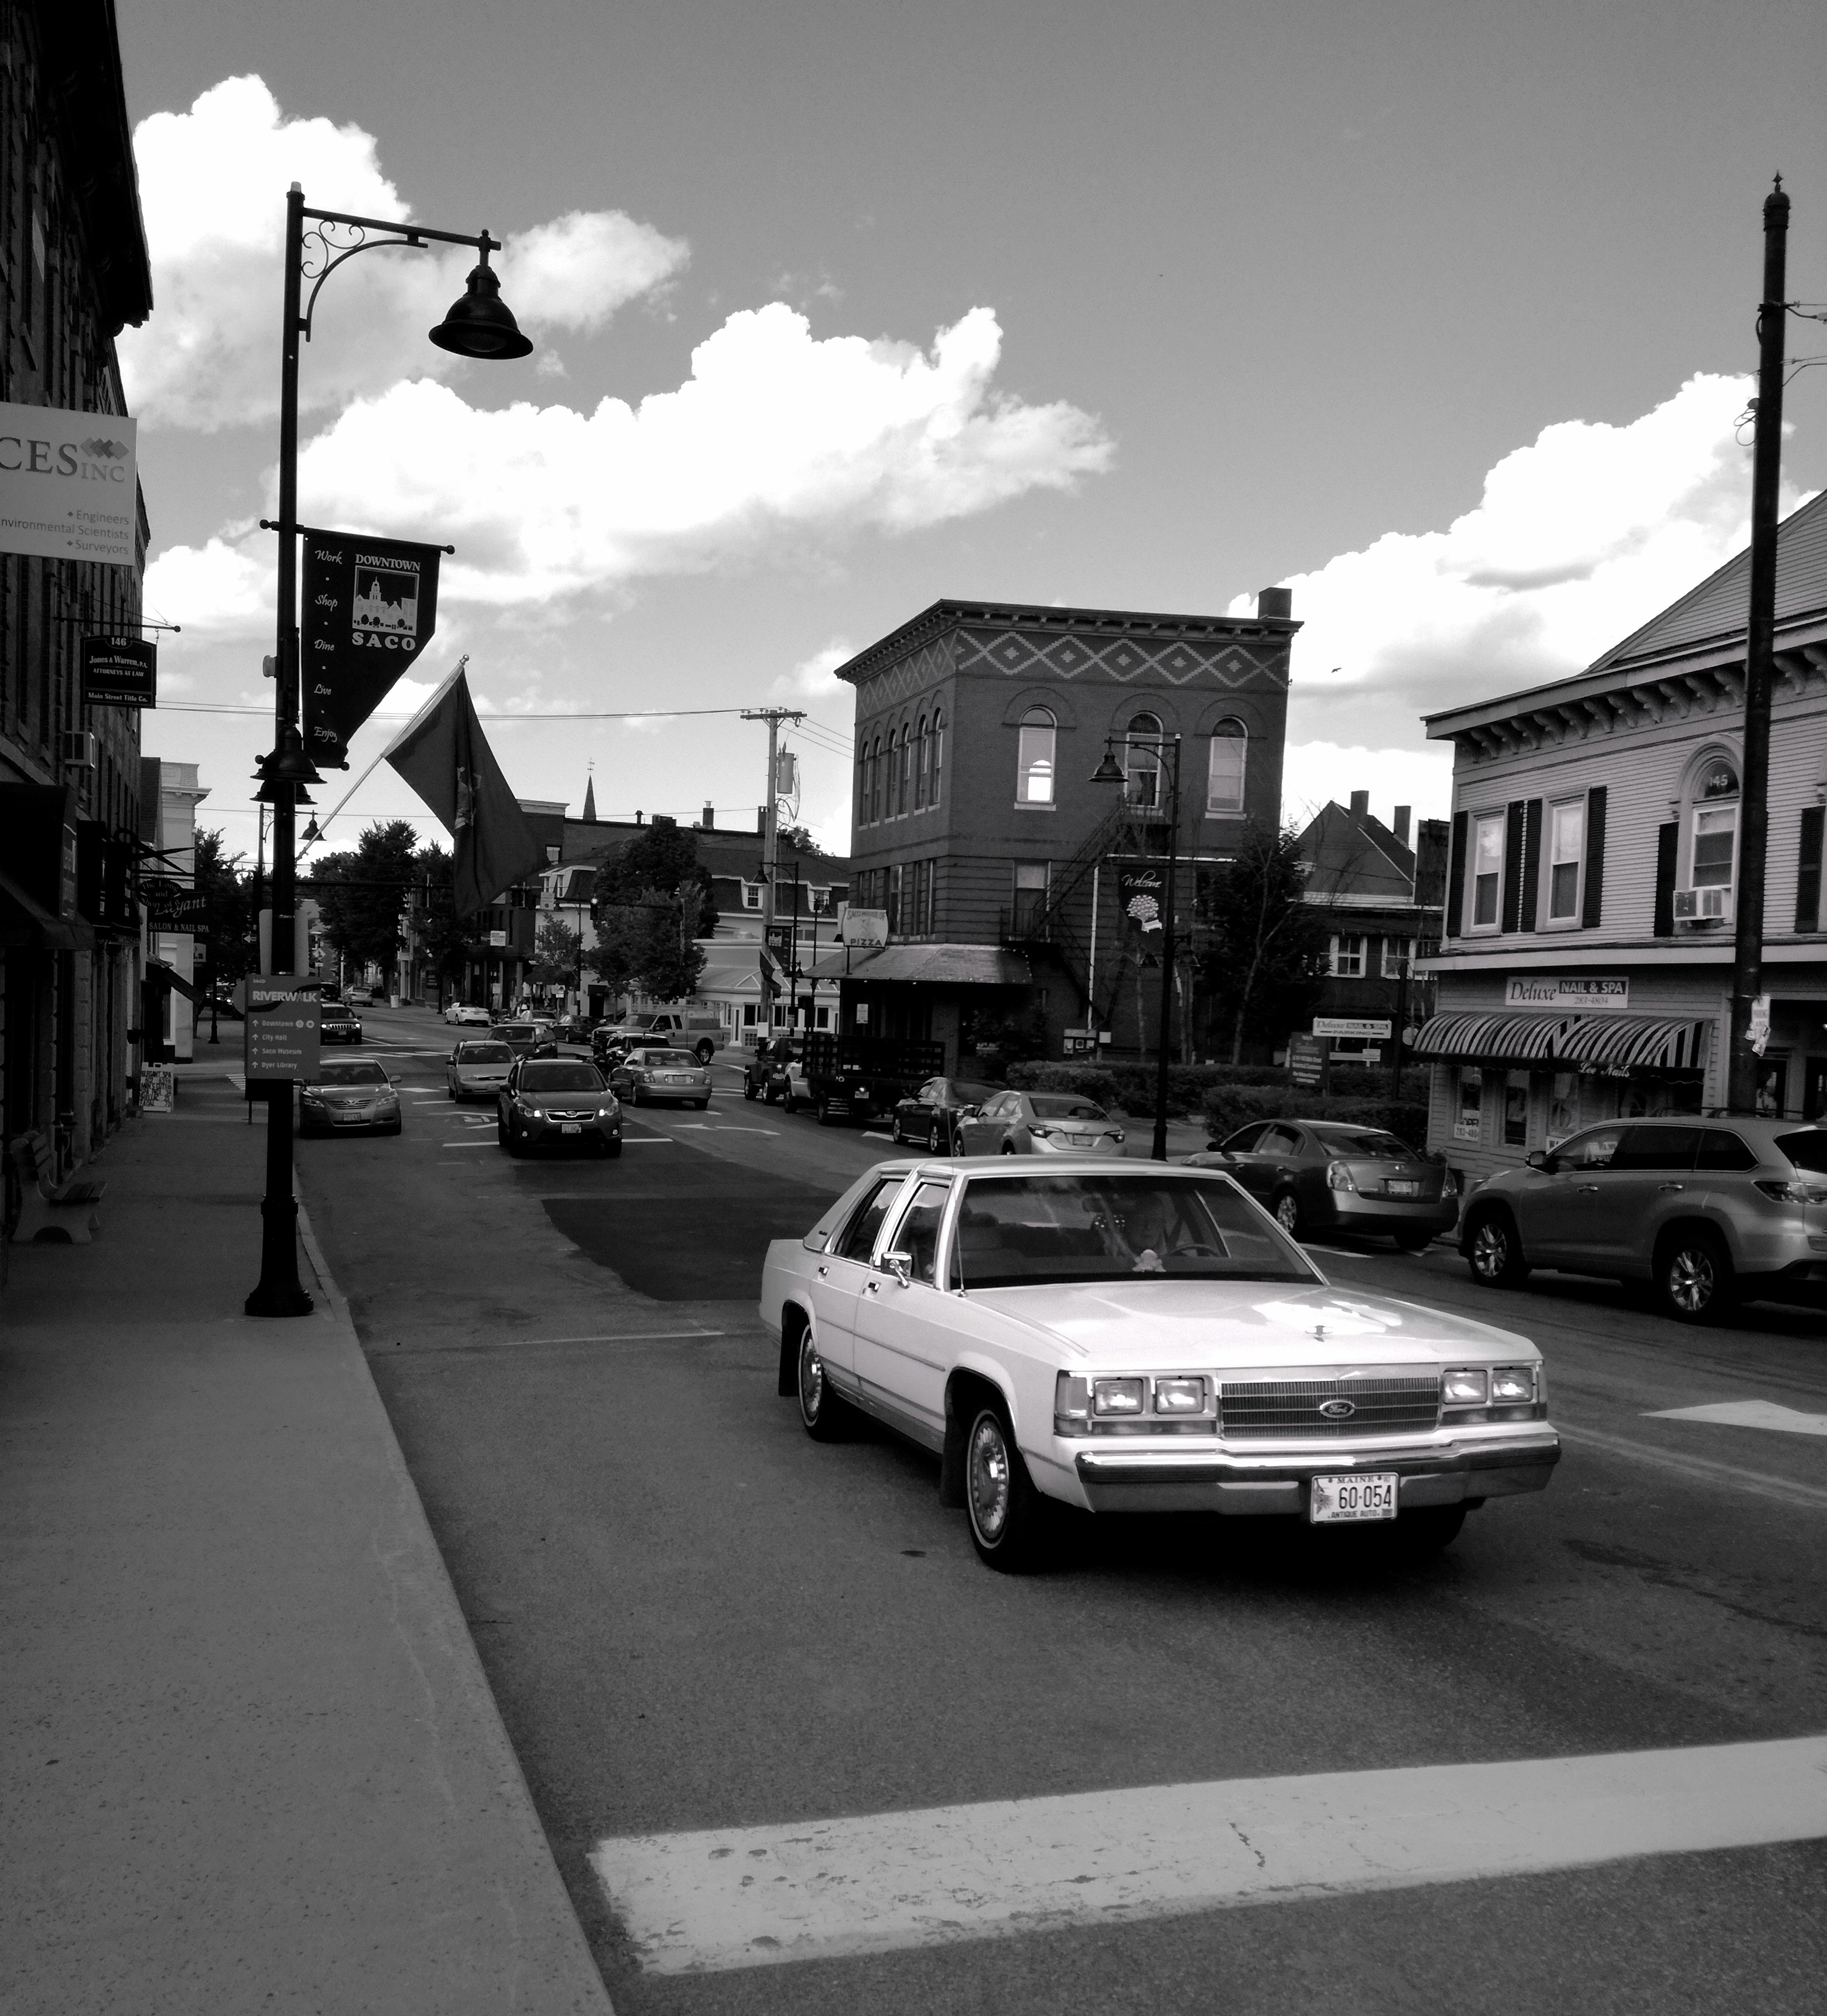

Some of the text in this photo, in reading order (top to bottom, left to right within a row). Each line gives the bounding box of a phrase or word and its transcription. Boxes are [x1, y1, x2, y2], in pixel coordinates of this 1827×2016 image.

[81, 462, 125, 482] INC
[76, 509, 129, 525] Engineers
[77, 525, 129, 540] Scientists
[75, 539, 129, 555] Surveyors
[314, 549, 343, 565] Work
[355, 553, 421, 571] DOWNTOWN
[314, 594, 338, 612] Shop
[111, 637, 127, 646] 146
[314, 638, 335, 652] Dine
[351, 631, 416, 651] SACO
[89, 655, 108, 664] Jones
[114, 655, 140, 667] Warren,
[93, 668, 123, 676] ATTORNEYS
[313, 683, 332, 696] Live
[104, 693, 122, 701] Street
[313, 726, 338, 742] Enjoy
[1709, 774, 1728, 786] 145
[1121, 870, 1162, 888] Welcome
[141, 880, 179, 892] The Long
[141, 897, 160, 909] Short
[847, 910, 885, 921] SACO HOUSE OF
[149, 922, 172, 930] SALON
[180, 923, 196, 932] NAIL
[197, 925, 210, 933] SPA
[850, 938, 882, 947] PIZZA
[252, 990, 317, 1002] RIVERWALK
[1510, 980, 1623, 1001] Deluxe NAIL & SPA
[1574, 996, 1609, 1005] 283-4804
[1316, 1021, 1345, 1029] Deluxe
[276, 1062, 297, 1070] Library
[1600, 1063, 1630, 1077] Nails
